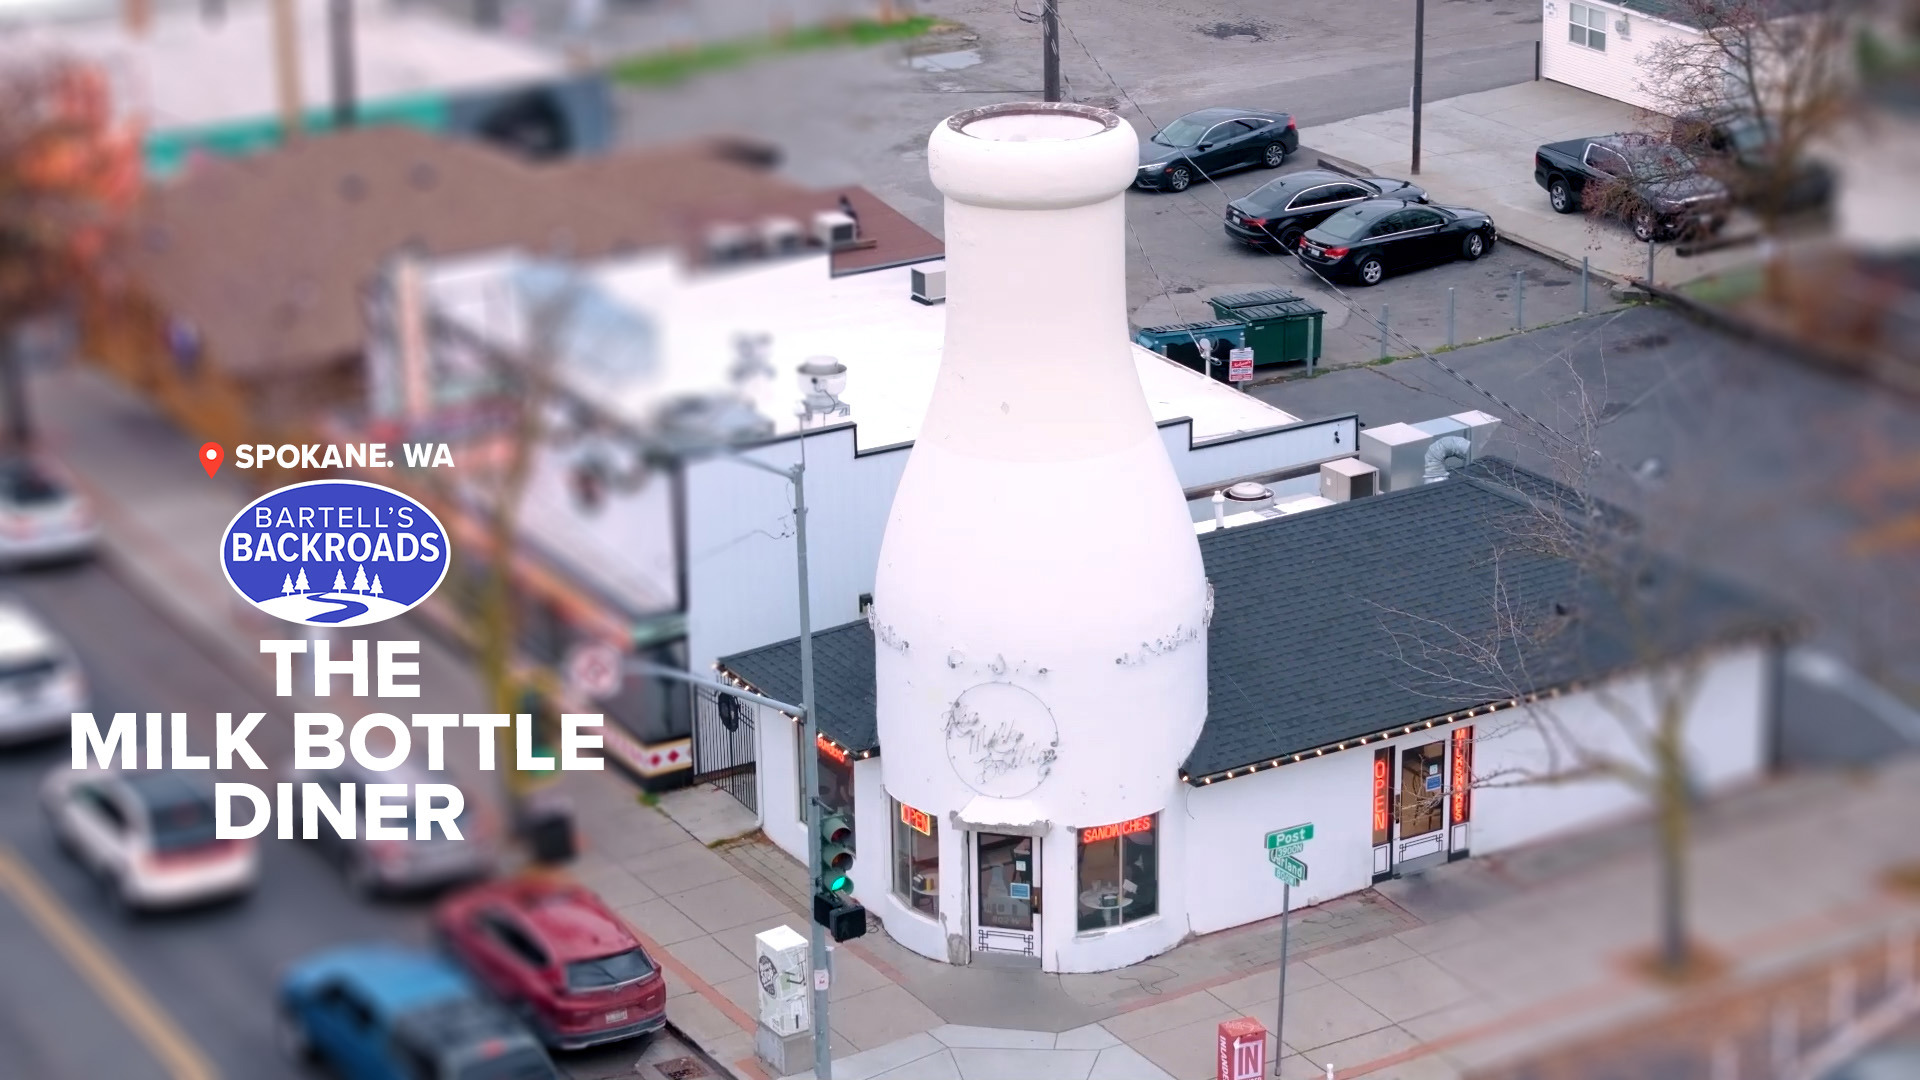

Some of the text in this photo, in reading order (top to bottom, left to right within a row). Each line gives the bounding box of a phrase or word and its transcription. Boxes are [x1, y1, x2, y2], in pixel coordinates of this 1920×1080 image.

[1374, 761, 1386, 831] OPEN
[902, 804, 928, 834] OPEN
[1083, 816, 1151, 844] SANDWCHES
[1276, 828, 1305, 846] Post
[1237, 1044, 1259, 1077] IN
